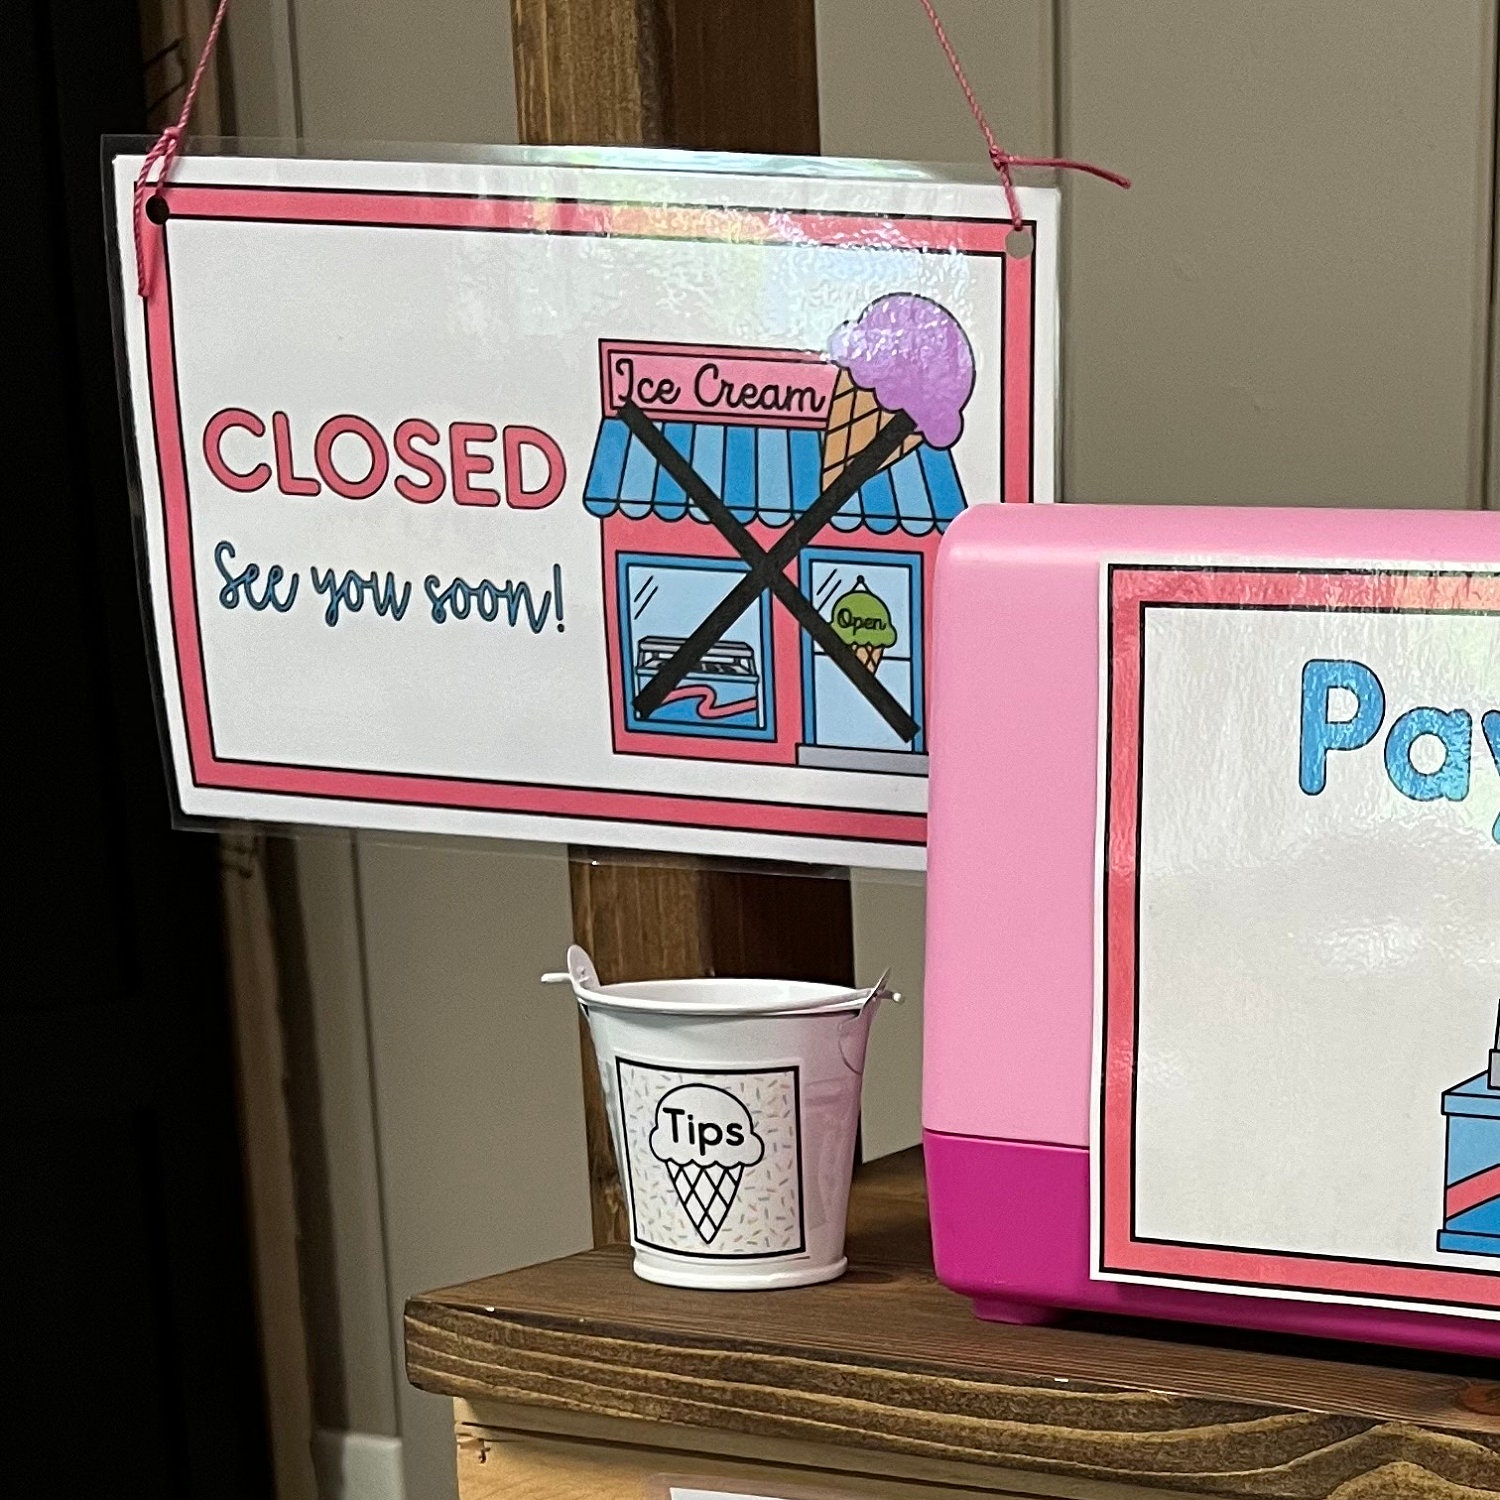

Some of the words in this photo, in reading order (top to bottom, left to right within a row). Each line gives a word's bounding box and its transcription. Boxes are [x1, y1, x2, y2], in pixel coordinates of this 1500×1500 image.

[616, 358, 681, 404] Ice
[694, 363, 826, 412] Cream
[202, 407, 567, 509] CLOSED
[214, 541, 300, 612] See
[310, 566, 412, 627] you
[424, 564, 565, 634] soon!
[837, 608, 887, 636] Open
[662, 1107, 745, 1156] Tips
